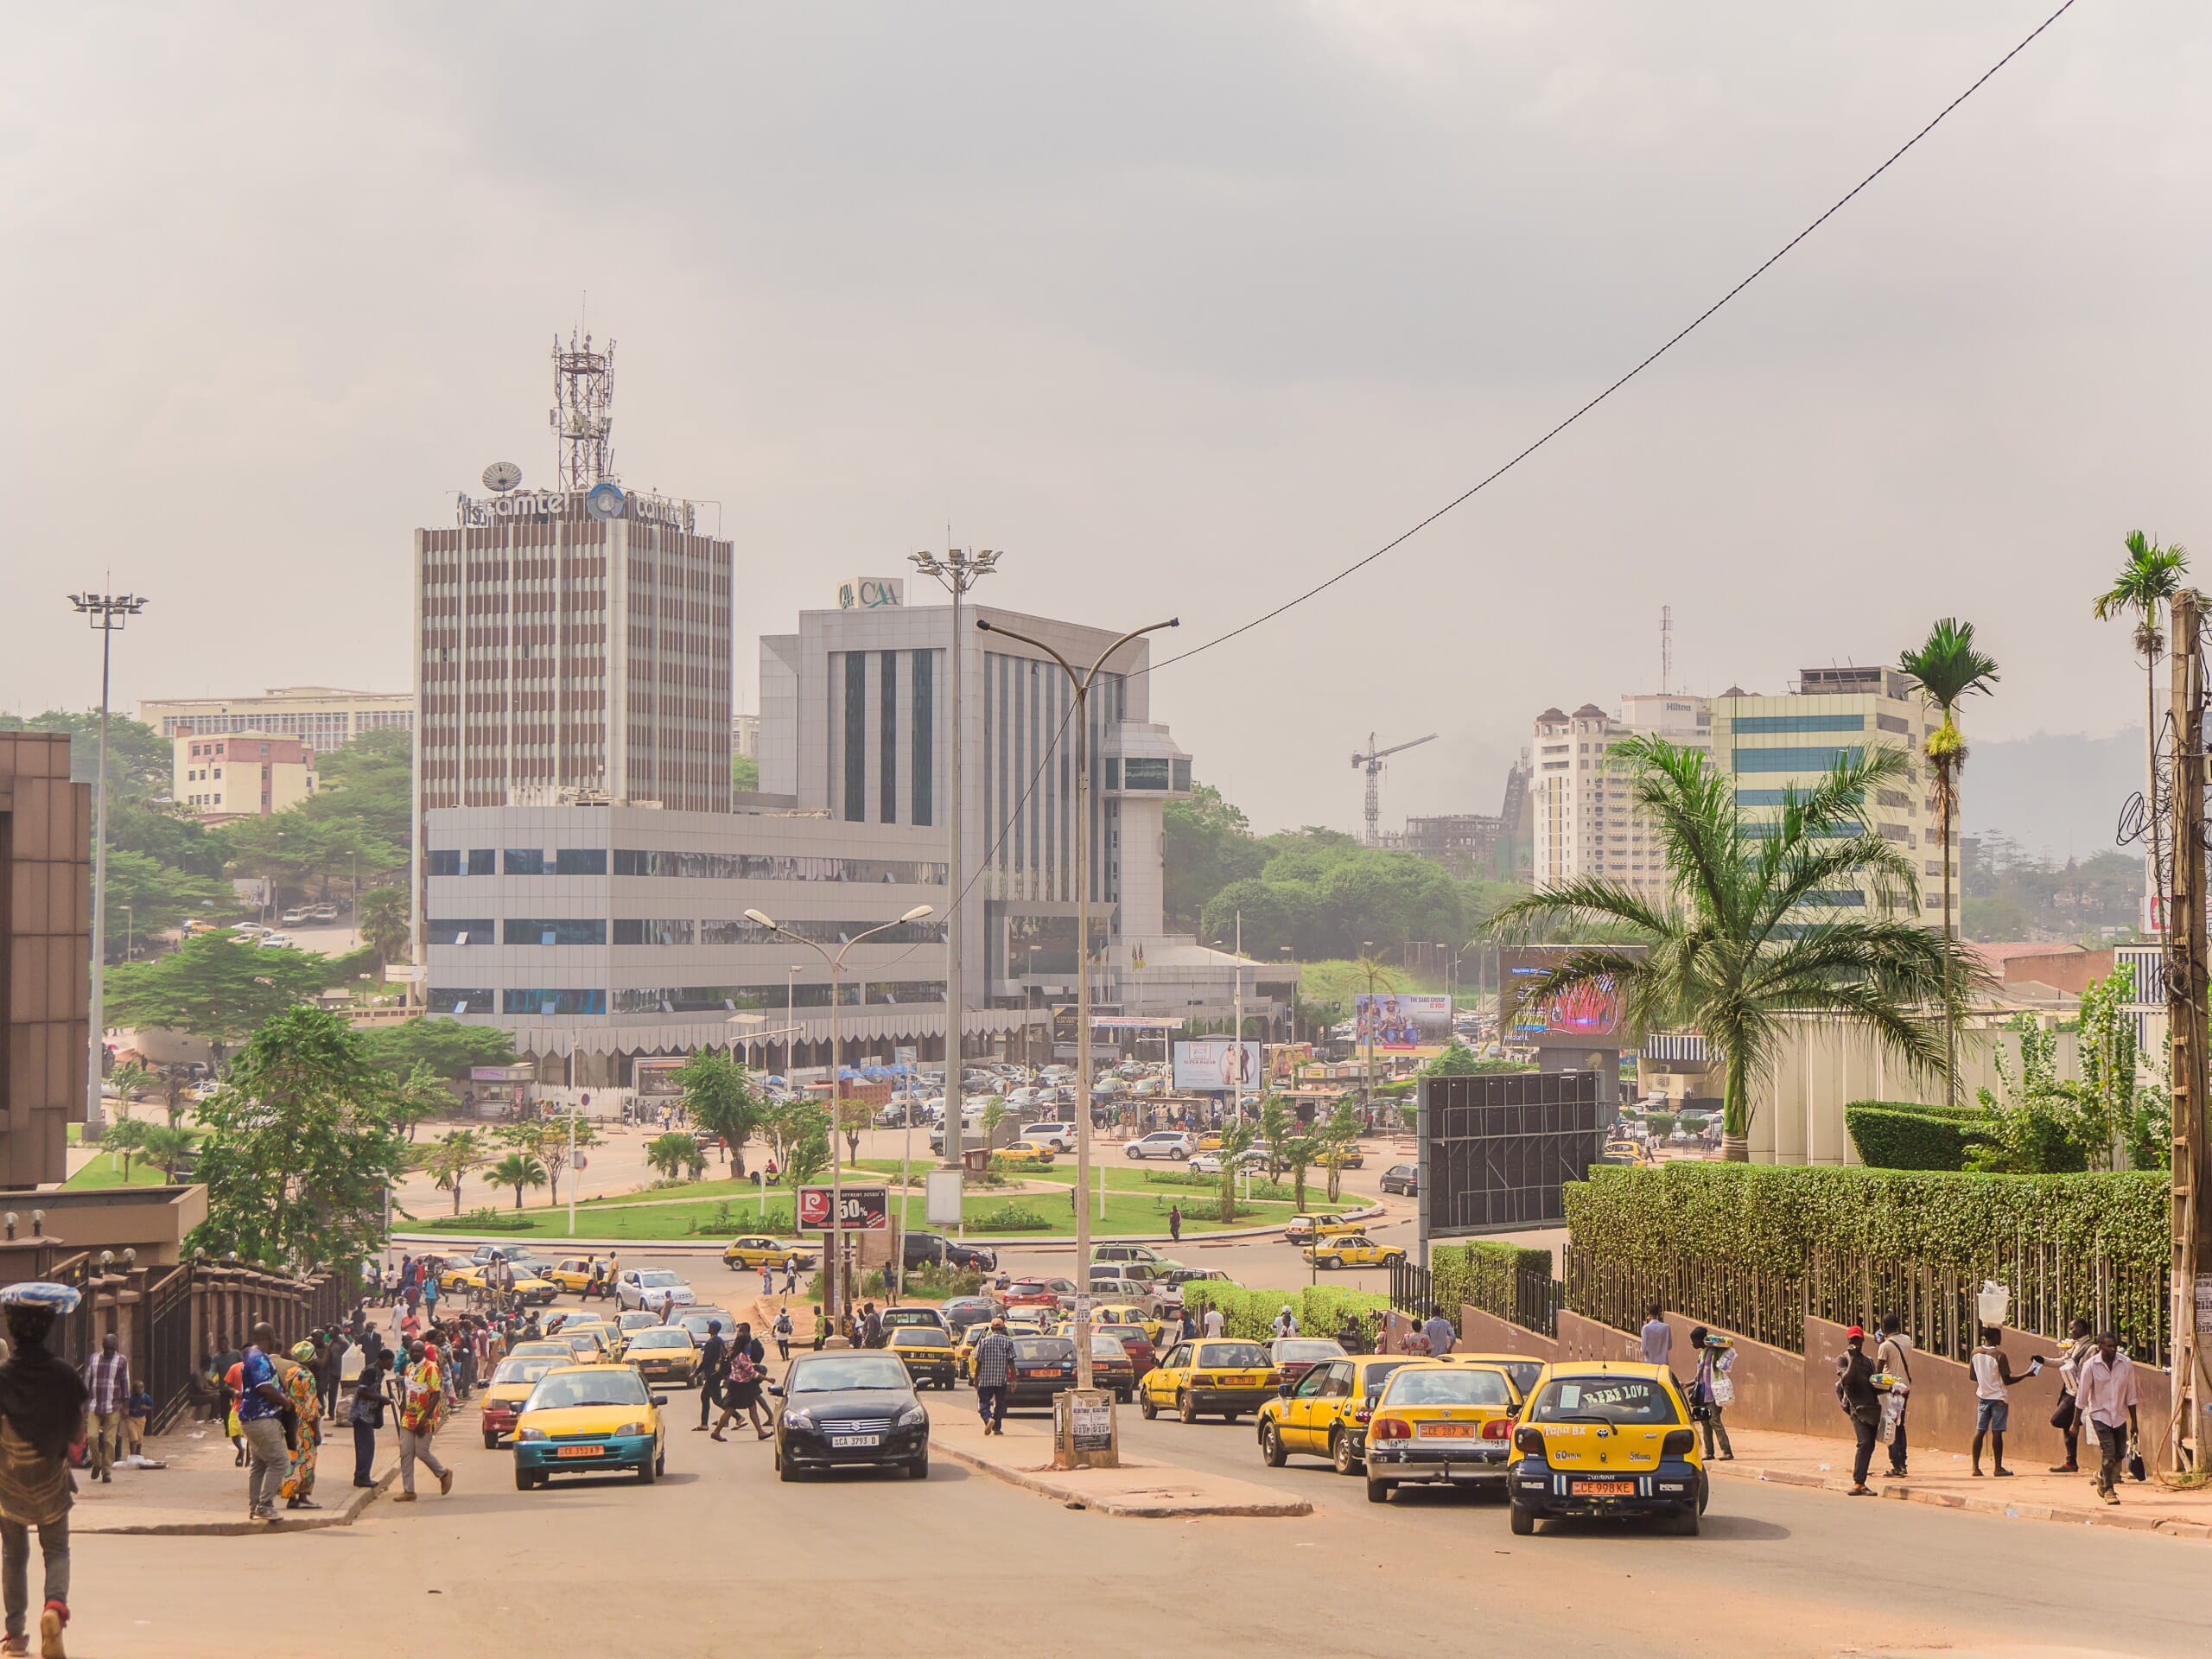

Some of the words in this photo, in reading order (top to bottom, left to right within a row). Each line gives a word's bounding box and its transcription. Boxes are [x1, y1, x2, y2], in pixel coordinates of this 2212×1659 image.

[484, 486, 570, 517] camtel
[1666, 702, 1692, 712] Hilton
[1622, 1384, 1649, 1399] LOVE
[1428, 1427, 1438, 1436] CE
[839, 1437, 848, 1446] CA
[851, 1437, 868, 1446] 3793
[1580, 1483, 1594, 1493] CE
[1596, 1483, 1615, 1493] 998
[1617, 1483, 1630, 1493] KE
